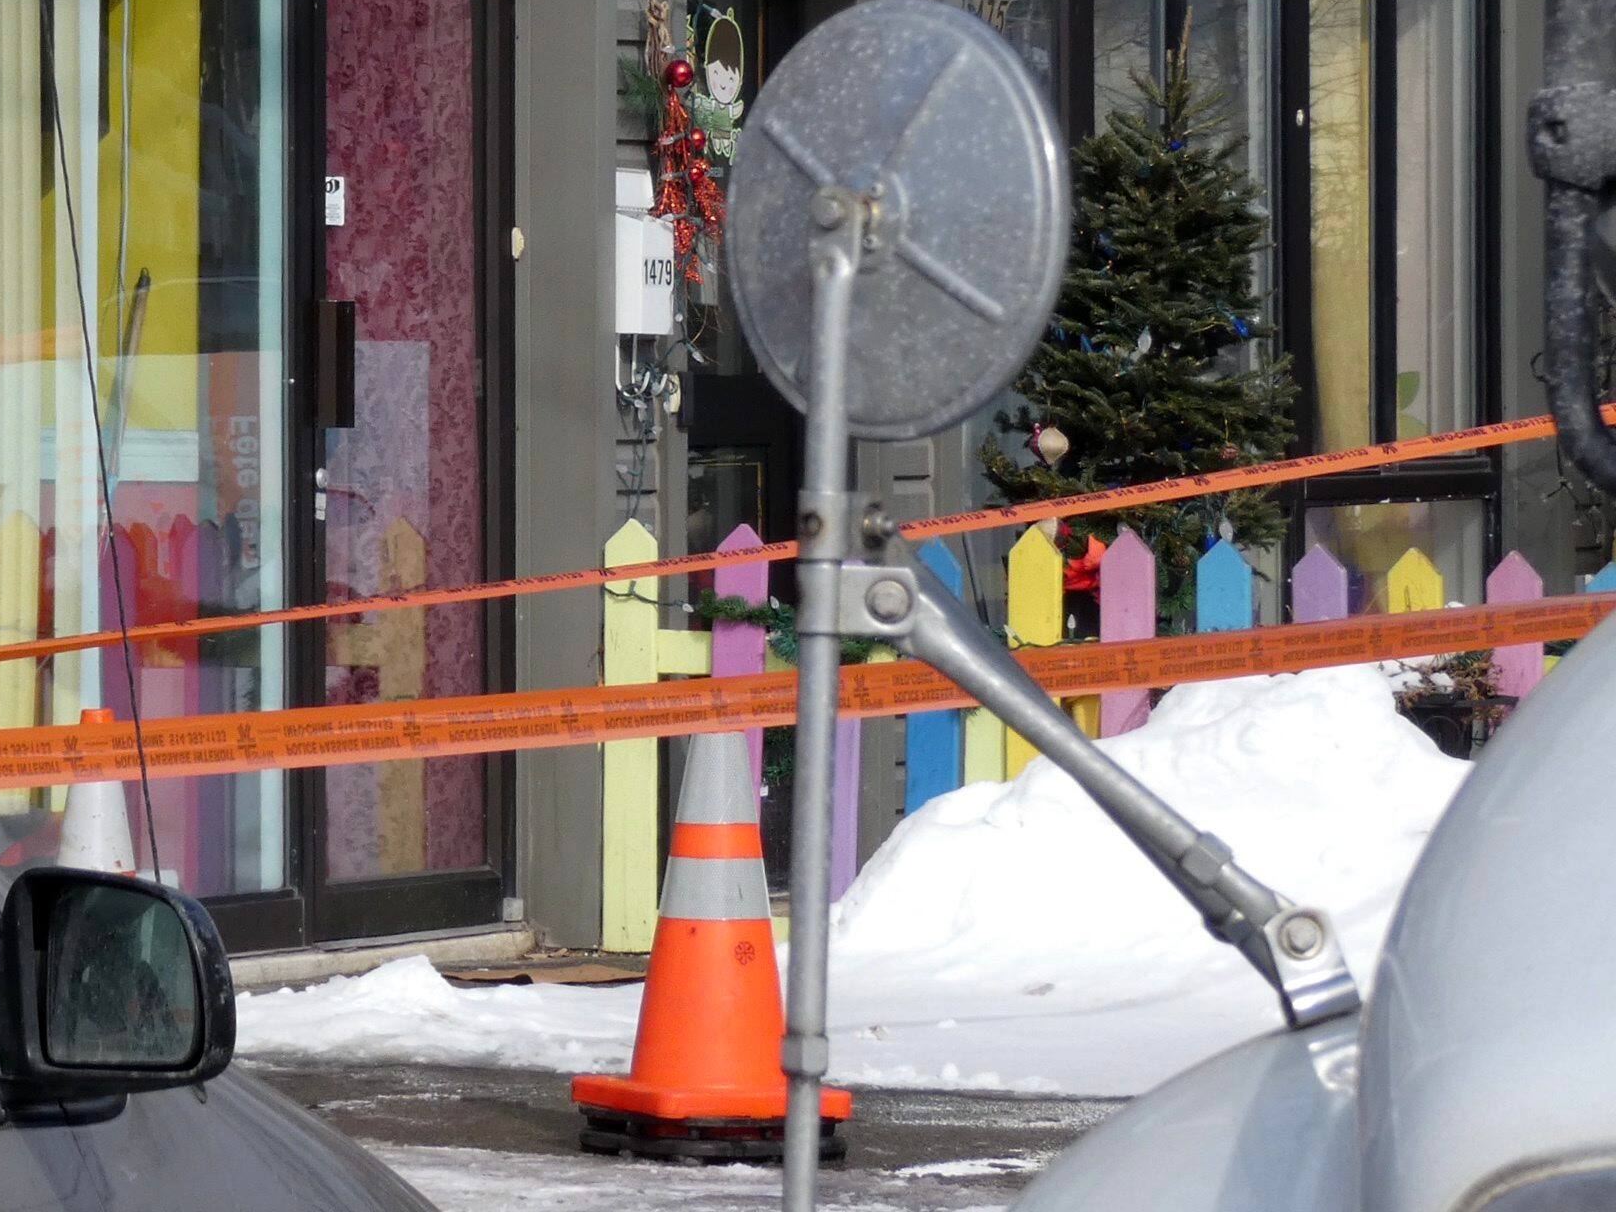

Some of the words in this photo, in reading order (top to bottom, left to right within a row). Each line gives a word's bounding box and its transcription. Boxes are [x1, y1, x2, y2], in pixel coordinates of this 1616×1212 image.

[644, 257, 673, 286] 1479
[1430, 428, 1487, 443] INFO-CRIME
[1491, 423, 1509, 433] 514
[1244, 461, 1299, 476] INFO-CRIME
[1305, 456, 1323, 467] 514
[1327, 449, 1369, 463] 393-1133
[1050, 492, 1109, 507] INFO-CRIME
[1114, 488, 1133, 499] 514
[1137, 481, 1180, 495] 393-1133
[919, 518, 938, 529] 514
[940, 512, 987, 526] 393-1133
[651, 553, 714, 568] INFO-CRIME
[718, 550, 739, 560] 514
[742, 543, 788, 558] 393-1133
